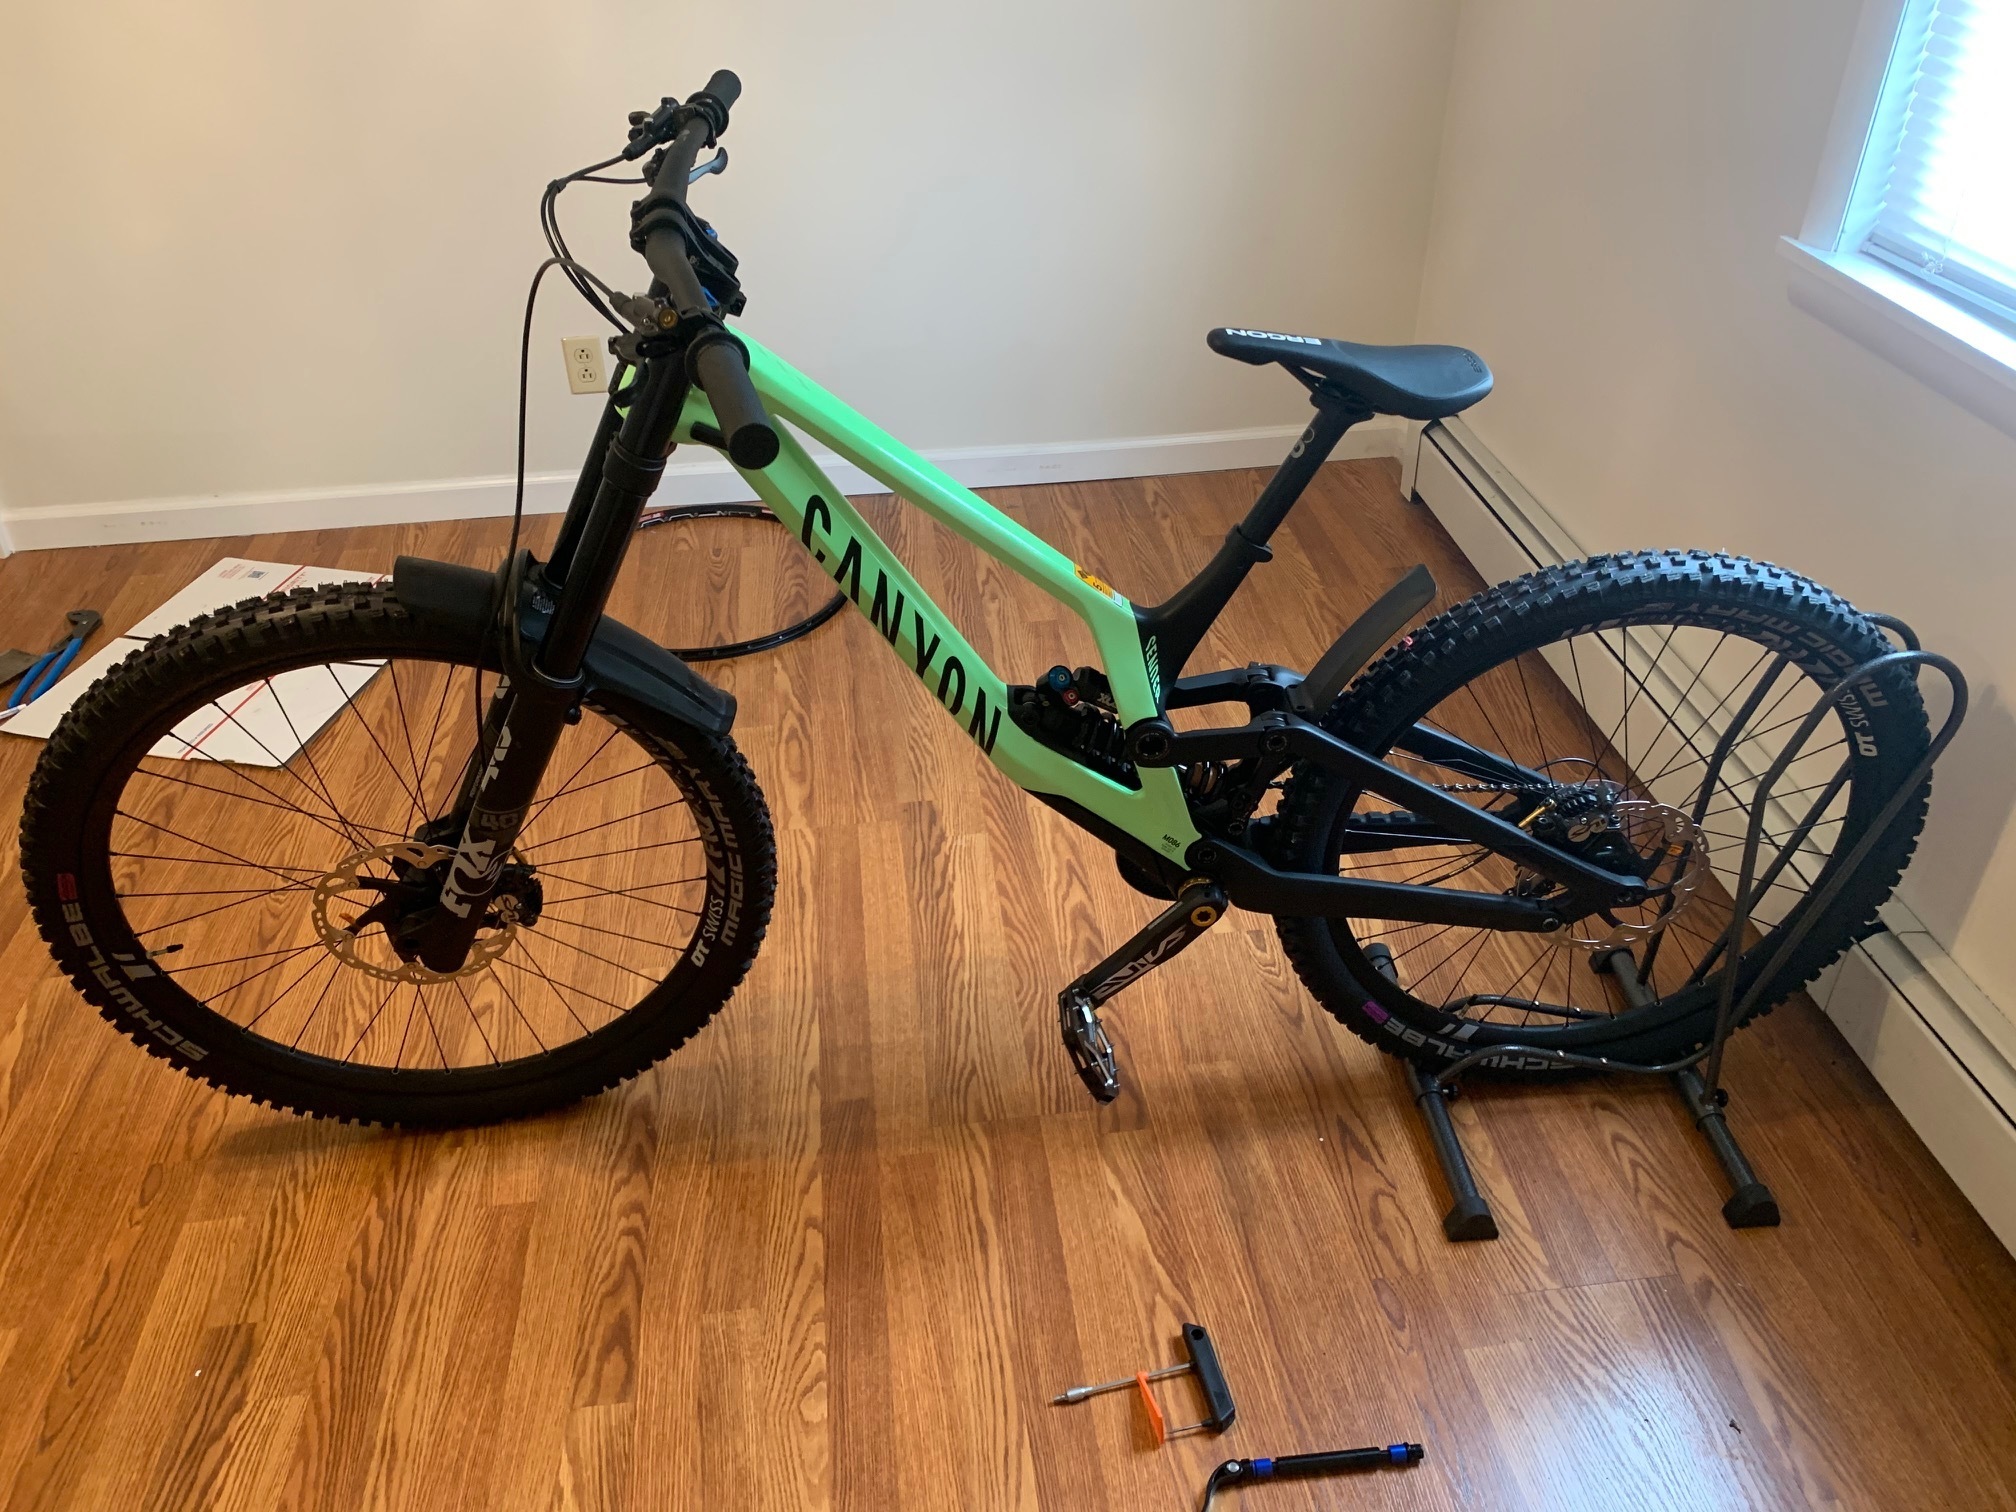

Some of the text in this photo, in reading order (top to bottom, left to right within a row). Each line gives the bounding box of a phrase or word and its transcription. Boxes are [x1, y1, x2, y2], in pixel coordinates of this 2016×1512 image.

[1225, 327, 1322, 346] ERGON
[801, 494, 1002, 757] CANYON
[1145, 635, 1162, 705] SENDER
[1799, 630, 1889, 707] MGIC
[1838, 691, 1870, 728] SWIS
[1853, 731, 1878, 757] DT
[440, 820, 500, 919] FOX
[682, 764, 744, 947] MAGIC MARY
[690, 938, 712, 968] DT
[702, 895, 725, 942] SWISS
[61, 902, 210, 1062] SCHWALBE
